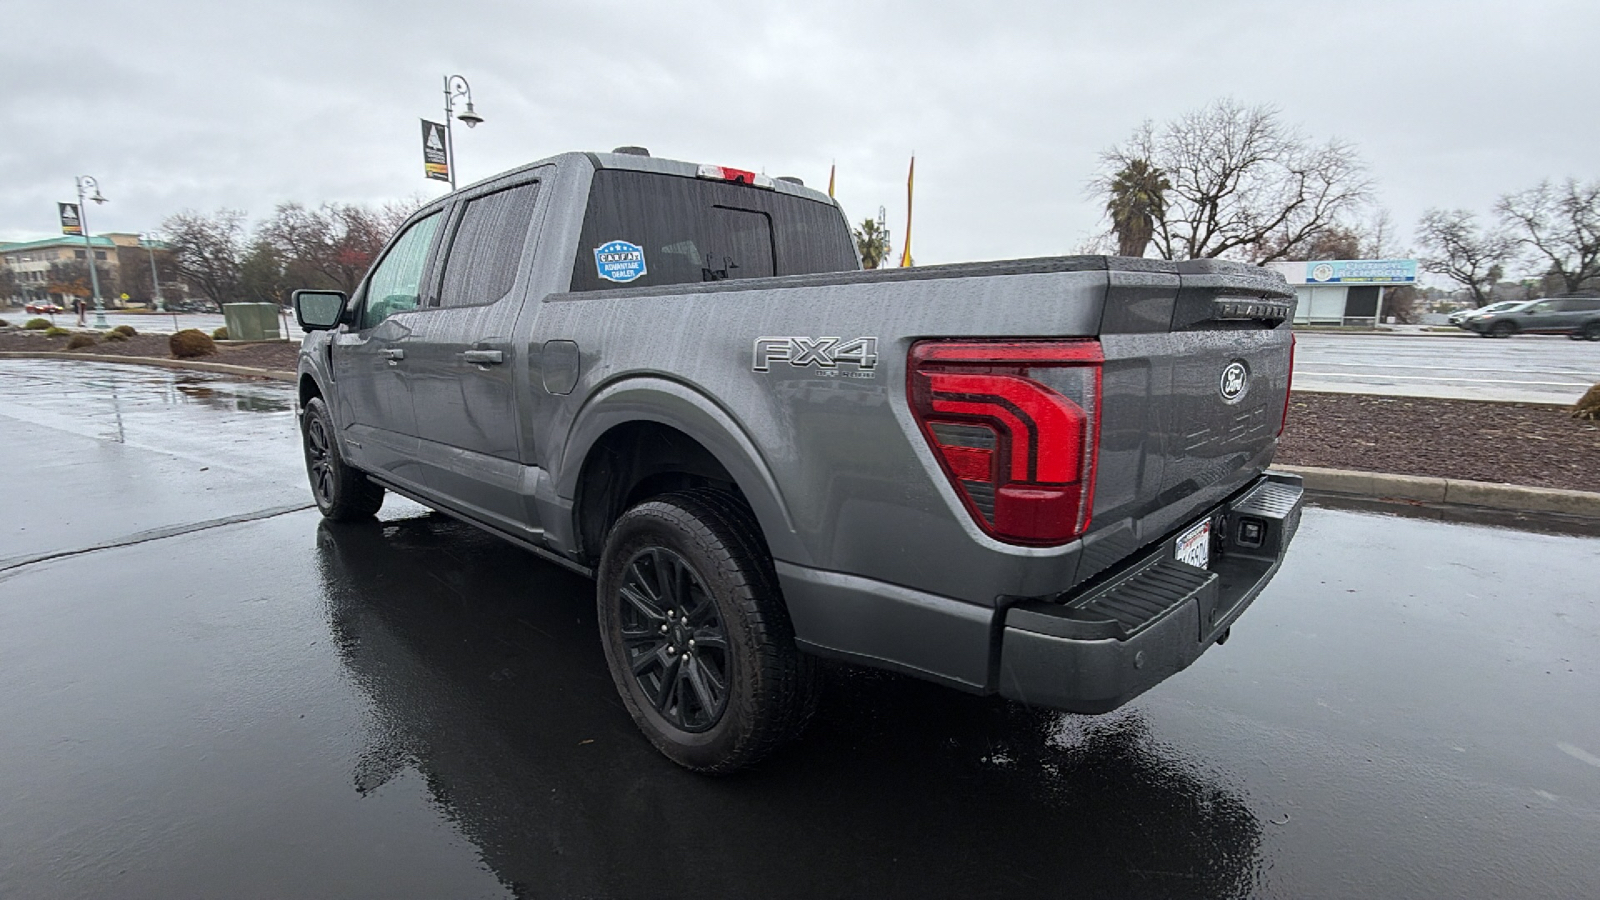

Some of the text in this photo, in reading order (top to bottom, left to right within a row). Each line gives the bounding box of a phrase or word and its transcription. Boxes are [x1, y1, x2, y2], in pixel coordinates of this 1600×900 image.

[599, 252, 641, 262] CARFAX
[604, 262, 639, 271] ADVANTAGE
[611, 270, 635, 278] DEALER
[752, 336, 878, 373] FX4
